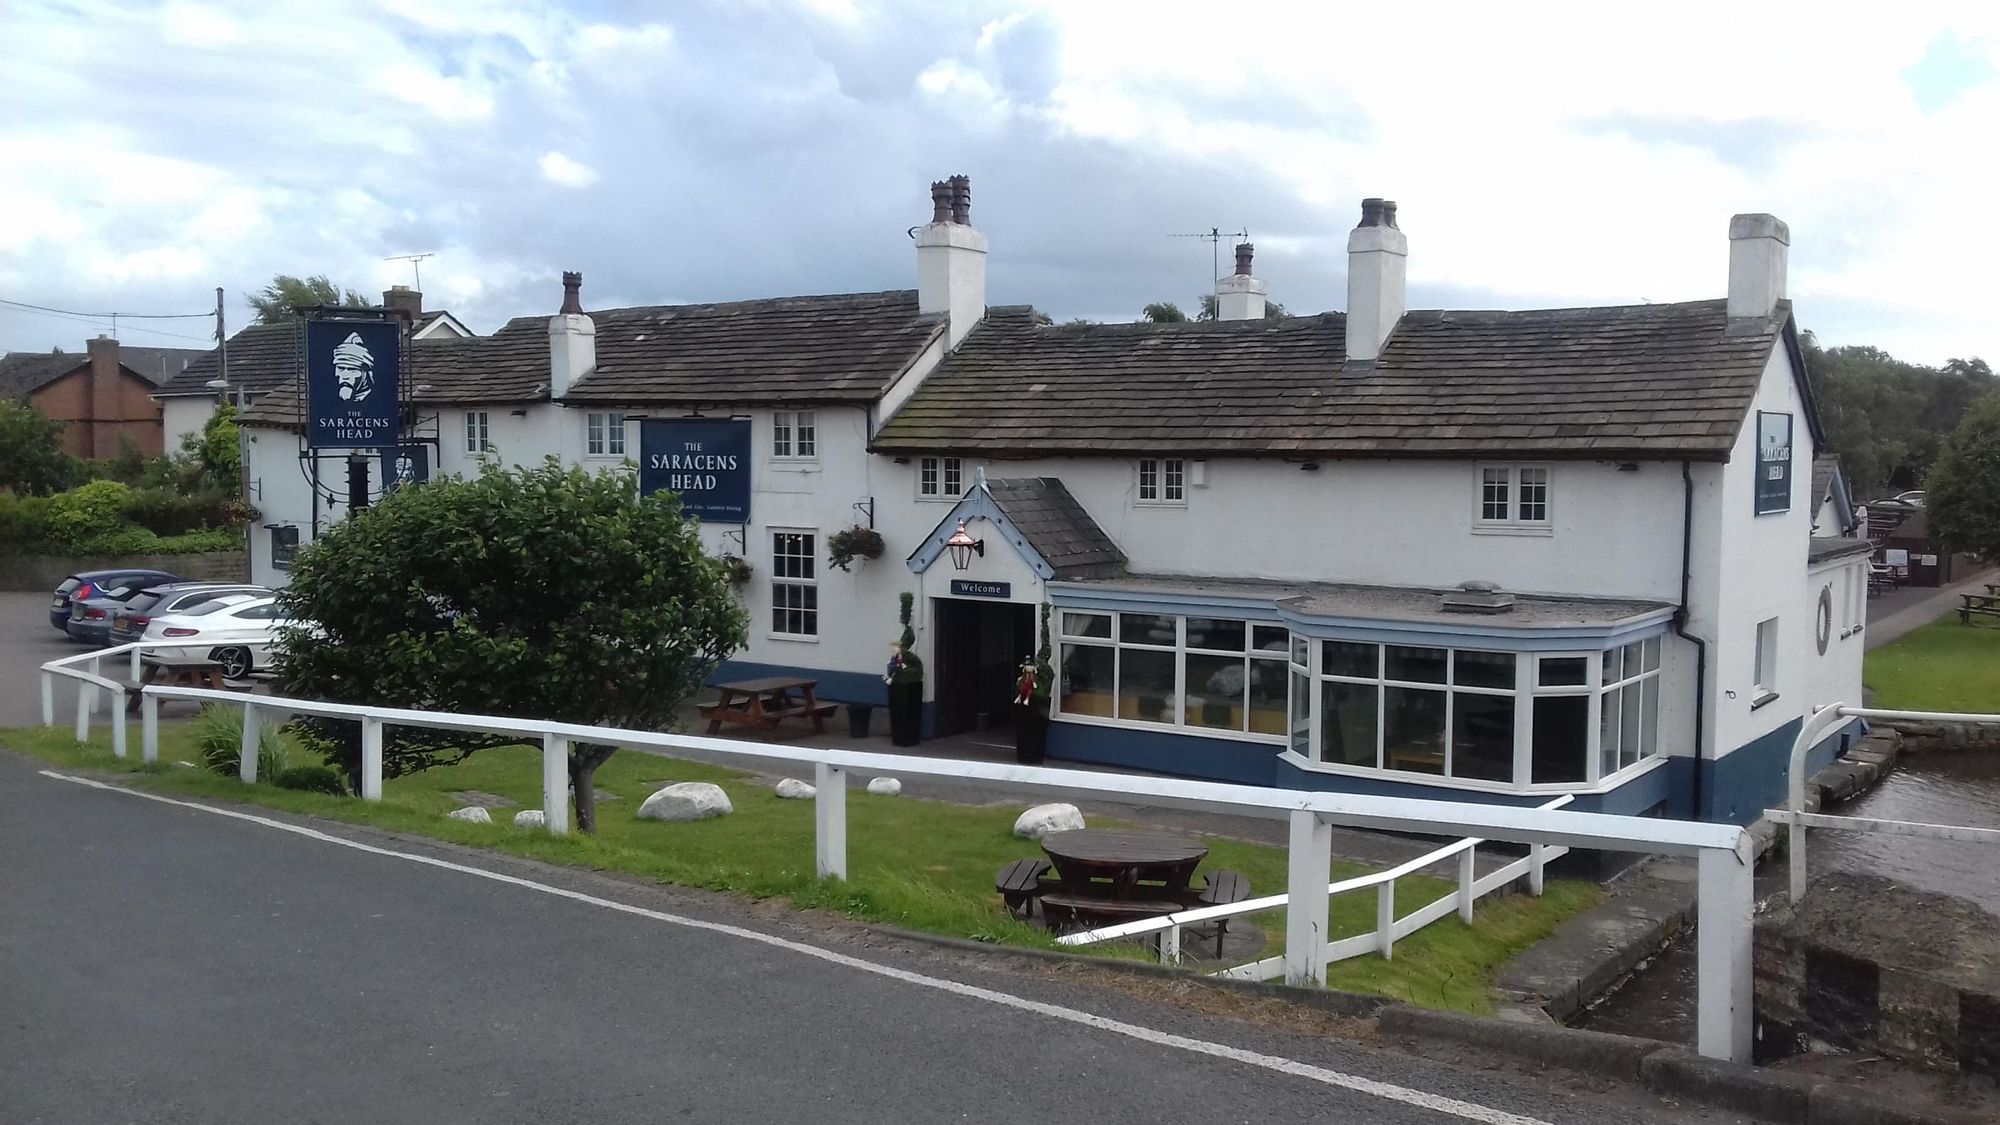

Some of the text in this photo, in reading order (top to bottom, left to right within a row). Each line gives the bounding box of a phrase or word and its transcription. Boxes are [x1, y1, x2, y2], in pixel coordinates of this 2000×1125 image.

[319, 418, 389, 428] SARACENS
[336, 429, 373, 439] HEAD
[684, 442, 703, 452] THE
[651, 453, 738, 471] SARACENS
[671, 474, 717, 490] HEAD
[960, 582, 1001, 594] Welcome
